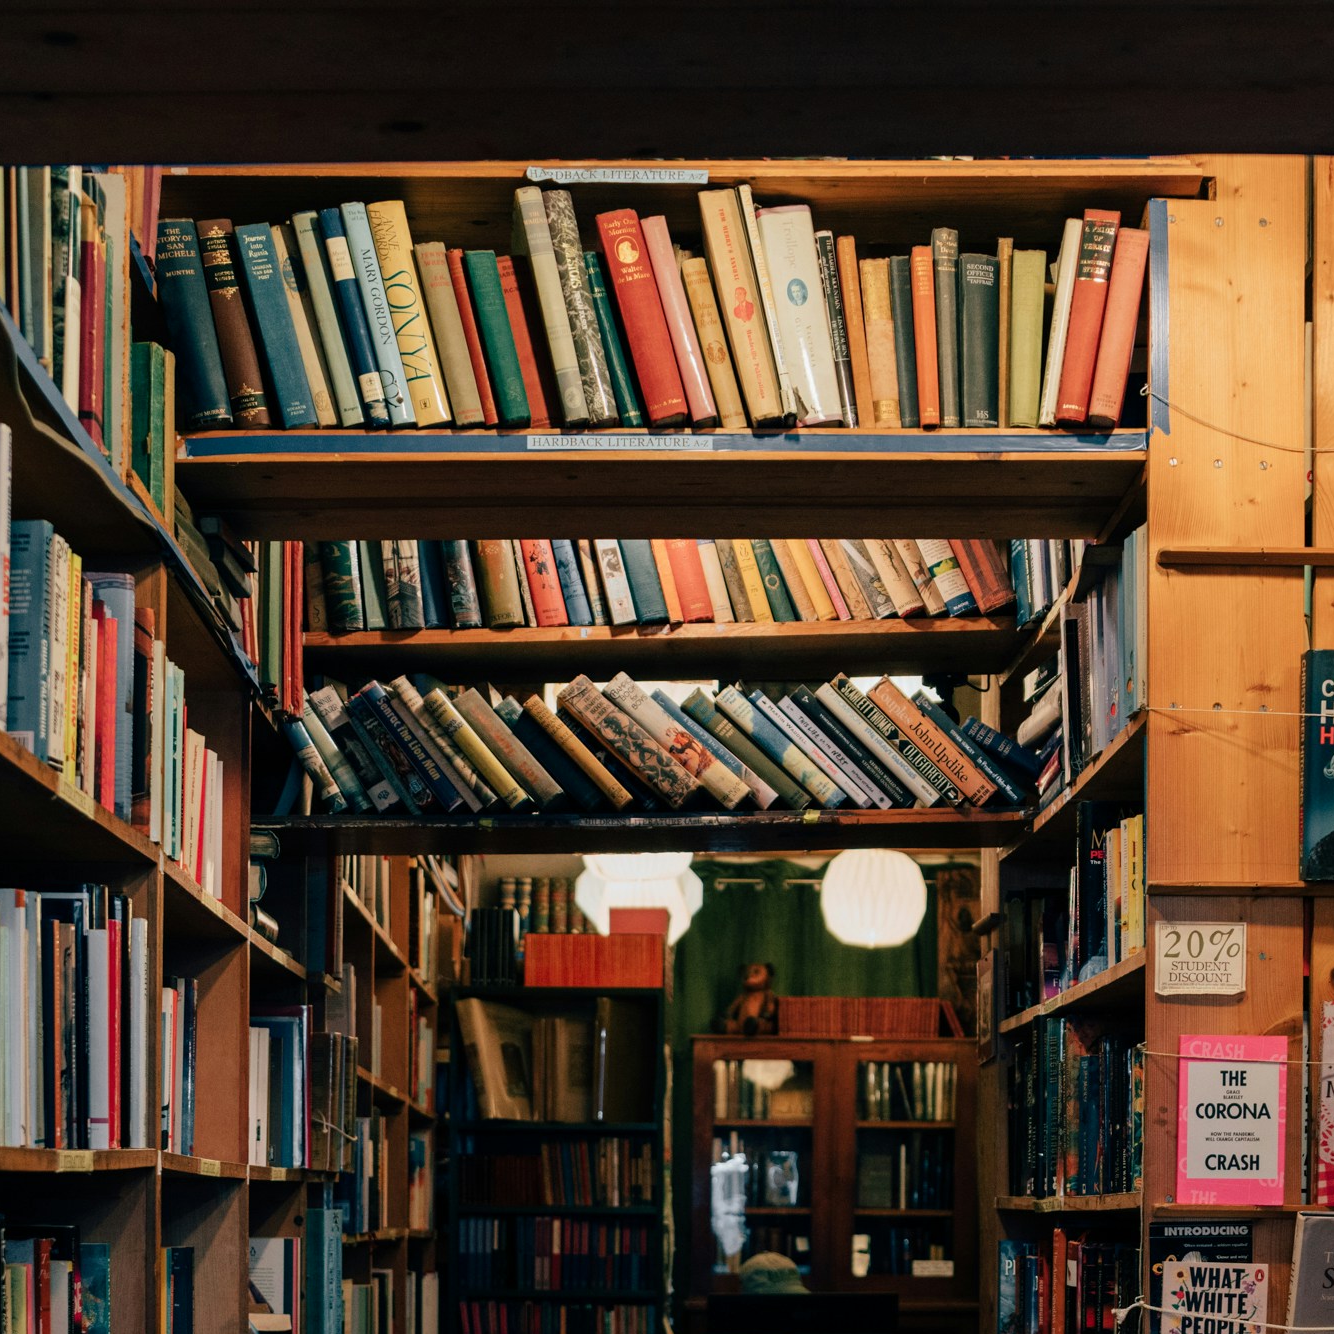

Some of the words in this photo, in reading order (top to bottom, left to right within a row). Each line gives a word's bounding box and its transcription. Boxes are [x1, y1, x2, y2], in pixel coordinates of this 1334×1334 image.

[530, 169, 597, 180] HARDBACK
[603, 170, 684, 180] LITERATURE
[603, 221, 621, 230] Early
[164, 228, 181, 236] THE
[379, 217, 400, 252] ANNE
[608, 226, 637, 236] Morning
[243, 234, 267, 244] Journey
[166, 242, 185, 250] SAN
[249, 242, 263, 250] into
[157, 250, 196, 260] MICHELE
[247, 248, 268, 258] Russia
[620, 264, 643, 274] Walter
[967, 263, 994, 272] SECOND
[166, 269, 195, 277] MUNTHE
[633, 271, 650, 280] Mare
[967, 270, 994, 278] OFFICER
[361, 248, 376, 284] MARY
[370, 283, 393, 346] GORDON
[383, 270, 431, 382] SONYA
[532, 438, 602, 446] HARDBACK
[608, 438, 690, 446] LITERATURE
[72, 572, 81, 656] PALAHNIUK
[39, 638, 48, 676] CHUCK
[39, 680, 48, 739] PALAHNIUK
[840, 682, 867, 713] SCARLETT
[867, 709, 896, 740] THOMAS
[903, 745, 954, 794] OLIGARCHY
[909, 721, 933, 745] John
[930, 743, 969, 783] Updike
[407, 741, 424, 759] Lion
[422, 757, 441, 781] Man
[1164, 928, 1240, 961] 20%
[1171, 961, 1230, 970] STUDENT
[1169, 973, 1231, 982] DISCOUNT
[1190, 1041, 1245, 1059] CRASH
[1220, 1070, 1247, 1086] THE
[1196, 1103, 1271, 1119] CORONA
[1205, 1154, 1260, 1170] CRASH
[1164, 1226, 1249, 1236] INTRODUCING
[1190, 1267, 1245, 1288] WHAT
[1184, 1292, 1249, 1315] WHITE
